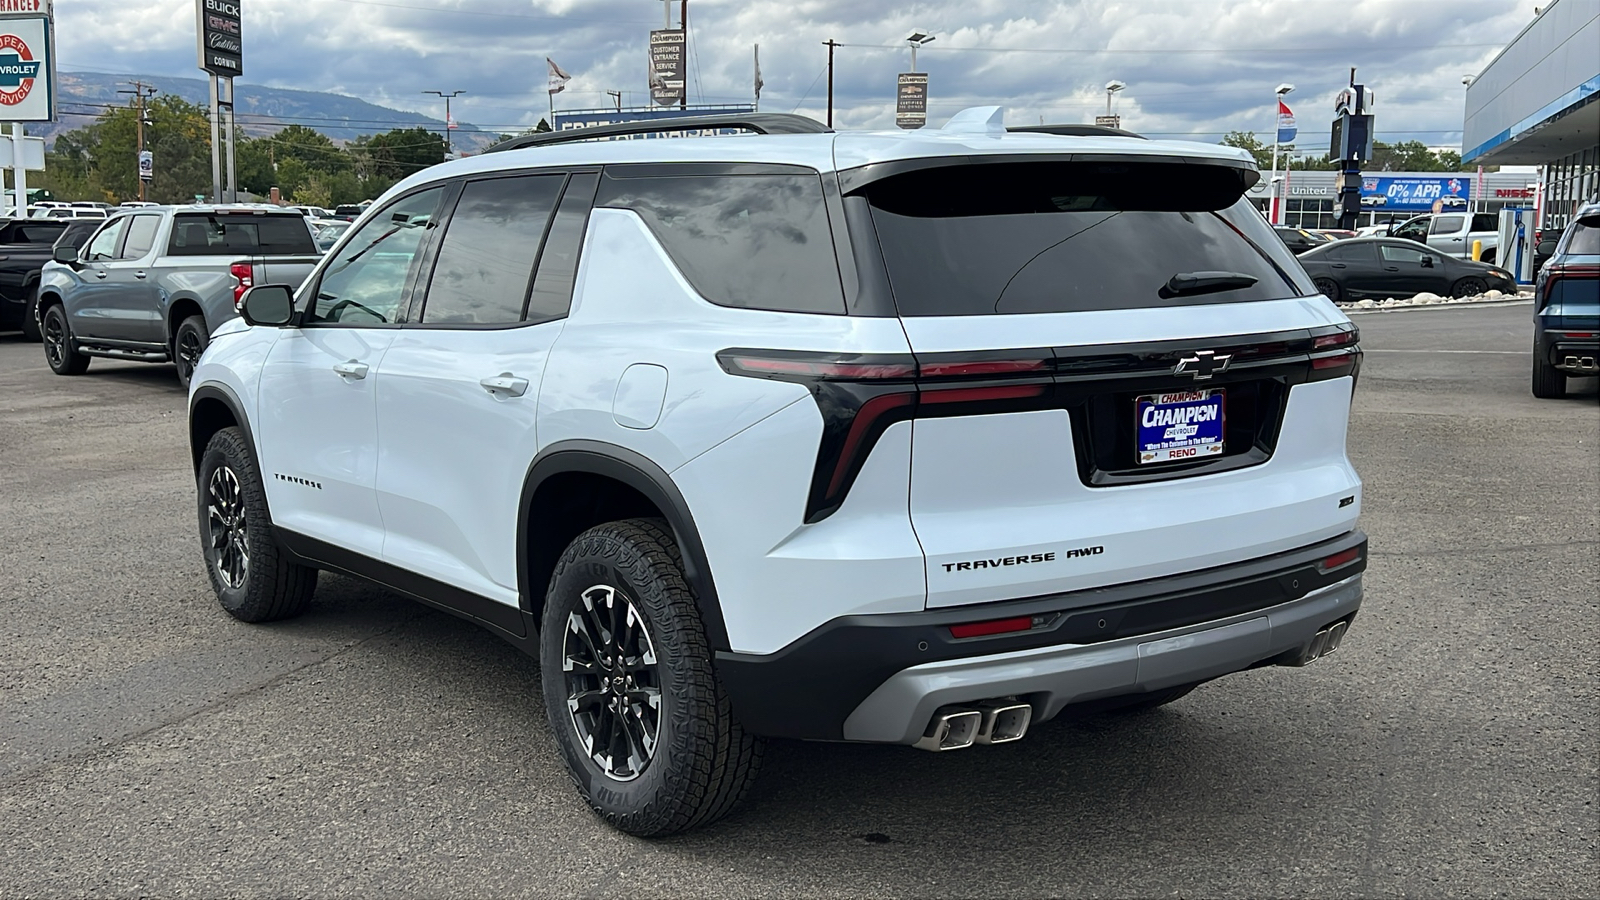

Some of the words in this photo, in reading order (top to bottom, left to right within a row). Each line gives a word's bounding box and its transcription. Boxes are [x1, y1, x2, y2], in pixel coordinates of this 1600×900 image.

[207, 0, 239, 17] BUICK
[209, 16, 239, 34] GMC
[209, 32, 239, 52] Cadillac
[652, 34, 683, 42] CHAMPION
[653, 46, 680, 54] CUSTOMER
[213, 56, 236, 69] CORWIN
[653, 53, 680, 61] ENTRANCE
[655, 62, 677, 70] SERVICE
[1292, 187, 1327, 195] United
[1387, 184, 1409, 198] 0%
[1412, 184, 1442, 198] APR
[1496, 189, 1535, 198] NISS
[1161, 391, 1203, 404] CHAMPION
[1142, 404, 1218, 428] CHAMPION
[1166, 427, 1196, 437] CHEVROLET
[1169, 448, 1196, 459] RENO
[274, 472, 322, 490] TRAVERSE
[942, 552, 1055, 573] TRAVERSE
[1066, 546, 1104, 559] AWD
